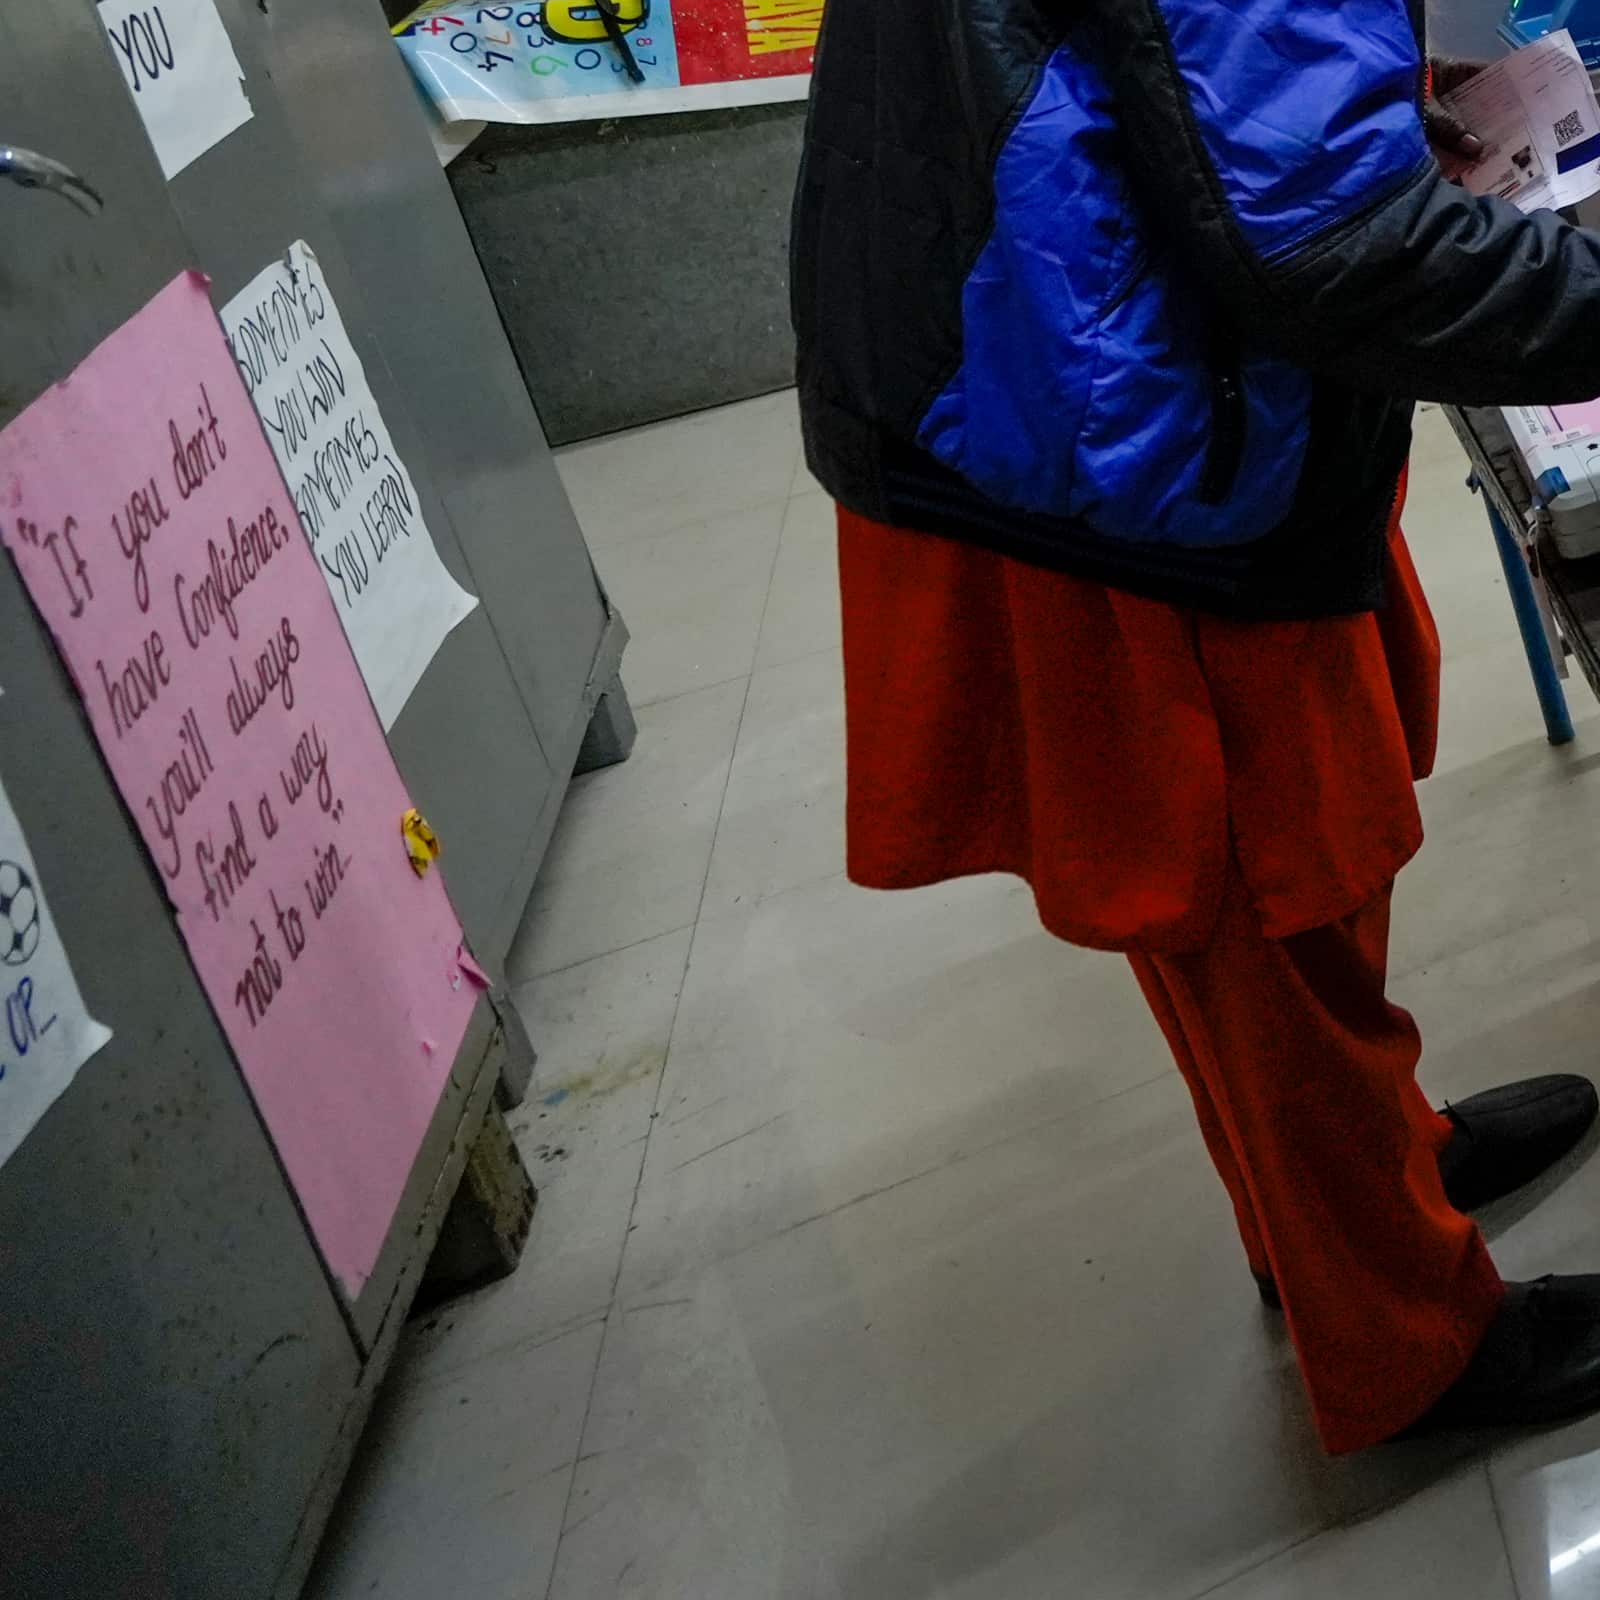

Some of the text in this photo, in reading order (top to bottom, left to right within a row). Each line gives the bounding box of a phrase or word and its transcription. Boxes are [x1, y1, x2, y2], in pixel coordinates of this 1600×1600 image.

[108, 5, 175, 93] YOU
[264, 337, 346, 463] YOU WIN
[111, 478, 170, 615] you
[168, 381, 227, 500] don't
[321, 454, 414, 609] YOU LEARN
[96, 630, 172, 741] have
[146, 617, 300, 880] you'll always
[196, 720, 332, 923] find a way
[234, 919, 283, 1029] not
[269, 888, 305, 962] to
